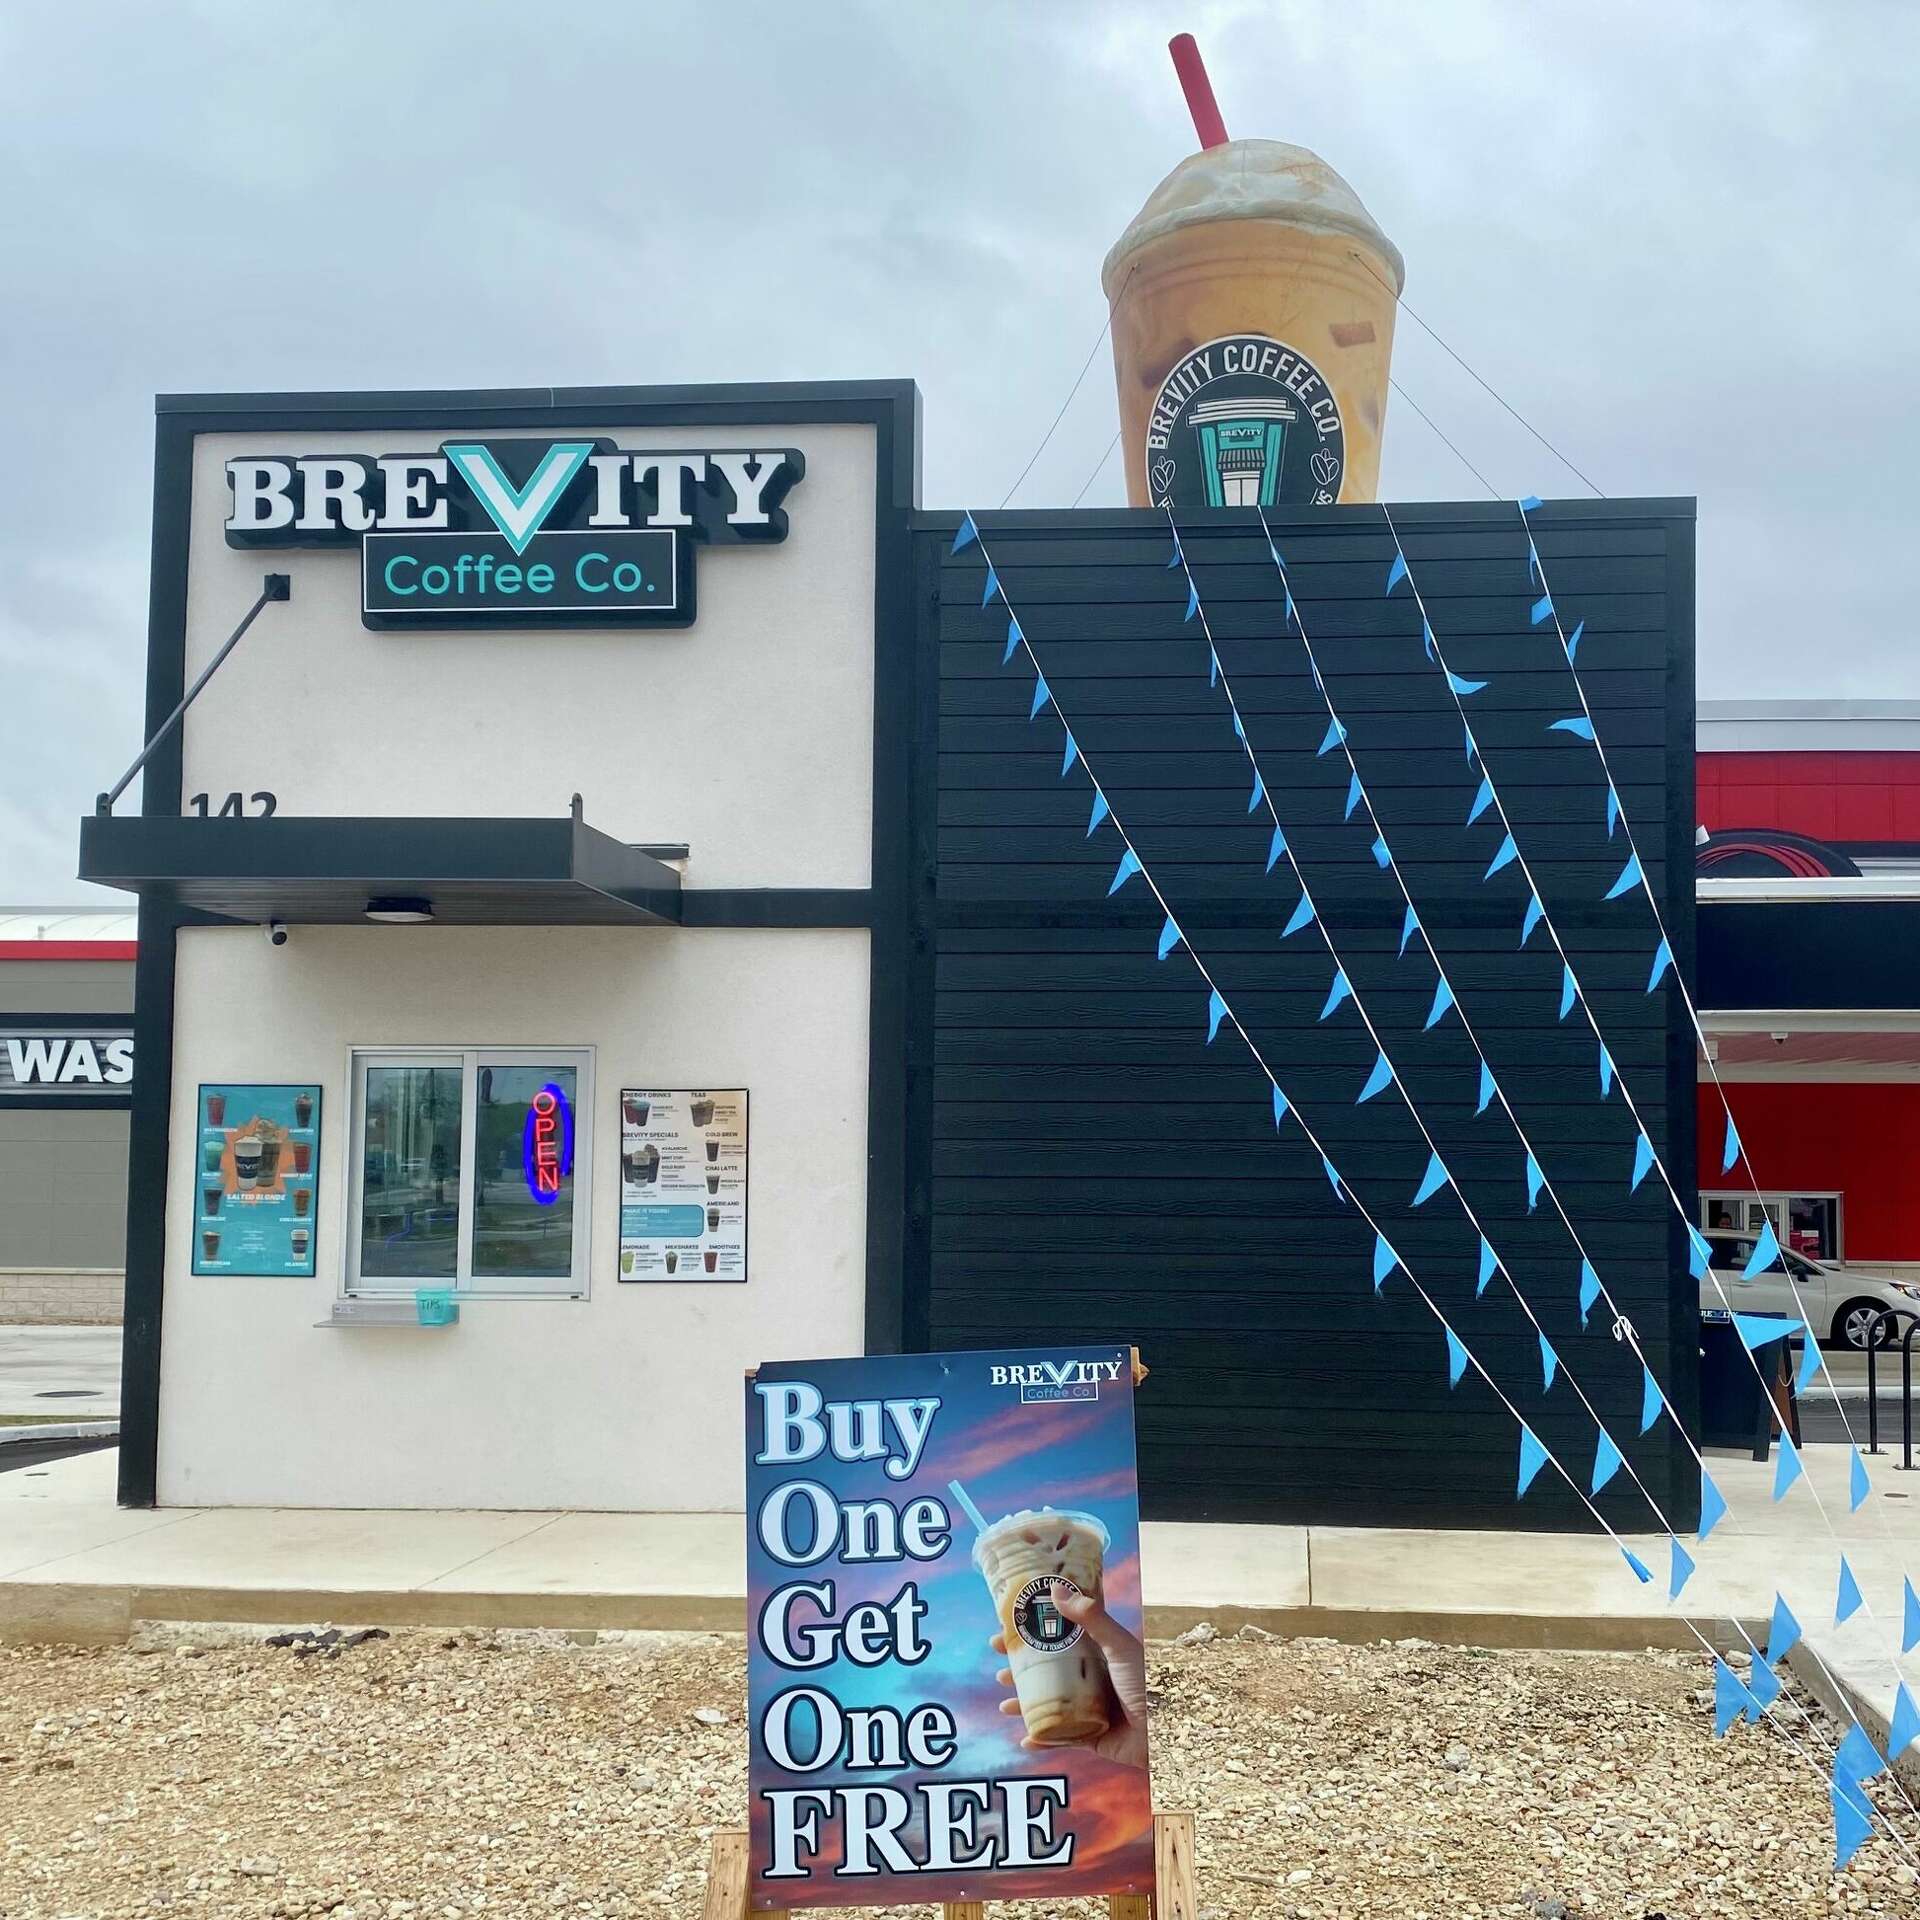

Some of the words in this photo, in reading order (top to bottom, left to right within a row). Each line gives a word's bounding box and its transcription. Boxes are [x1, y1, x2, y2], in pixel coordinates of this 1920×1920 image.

[1149, 352, 1214, 449] BREVITY
[1223, 344, 1321, 401] COFFEE
[1311, 398, 1340, 442] CO.
[1220, 428, 1262, 437] BREVITY
[225, 443, 786, 556] BREVITY
[384, 554, 555, 594] Coffee
[575, 552, 655, 593] Co.
[6, 1038, 134, 1084] WAS
[533, 1091, 558, 1191] OPEN
[990, 1360, 1122, 1389] BREVITY
[1027, 1387, 1069, 1400] Coffee
[1072, 1386, 1090, 1398] Co
[755, 1381, 941, 1480] Buy
[758, 1479, 951, 1567] One
[759, 1580, 931, 1671] Get
[1015, 1579, 1042, 1610] BREVITY
[762, 1684, 957, 1773] One
[761, 1776, 1075, 1877] FREE
